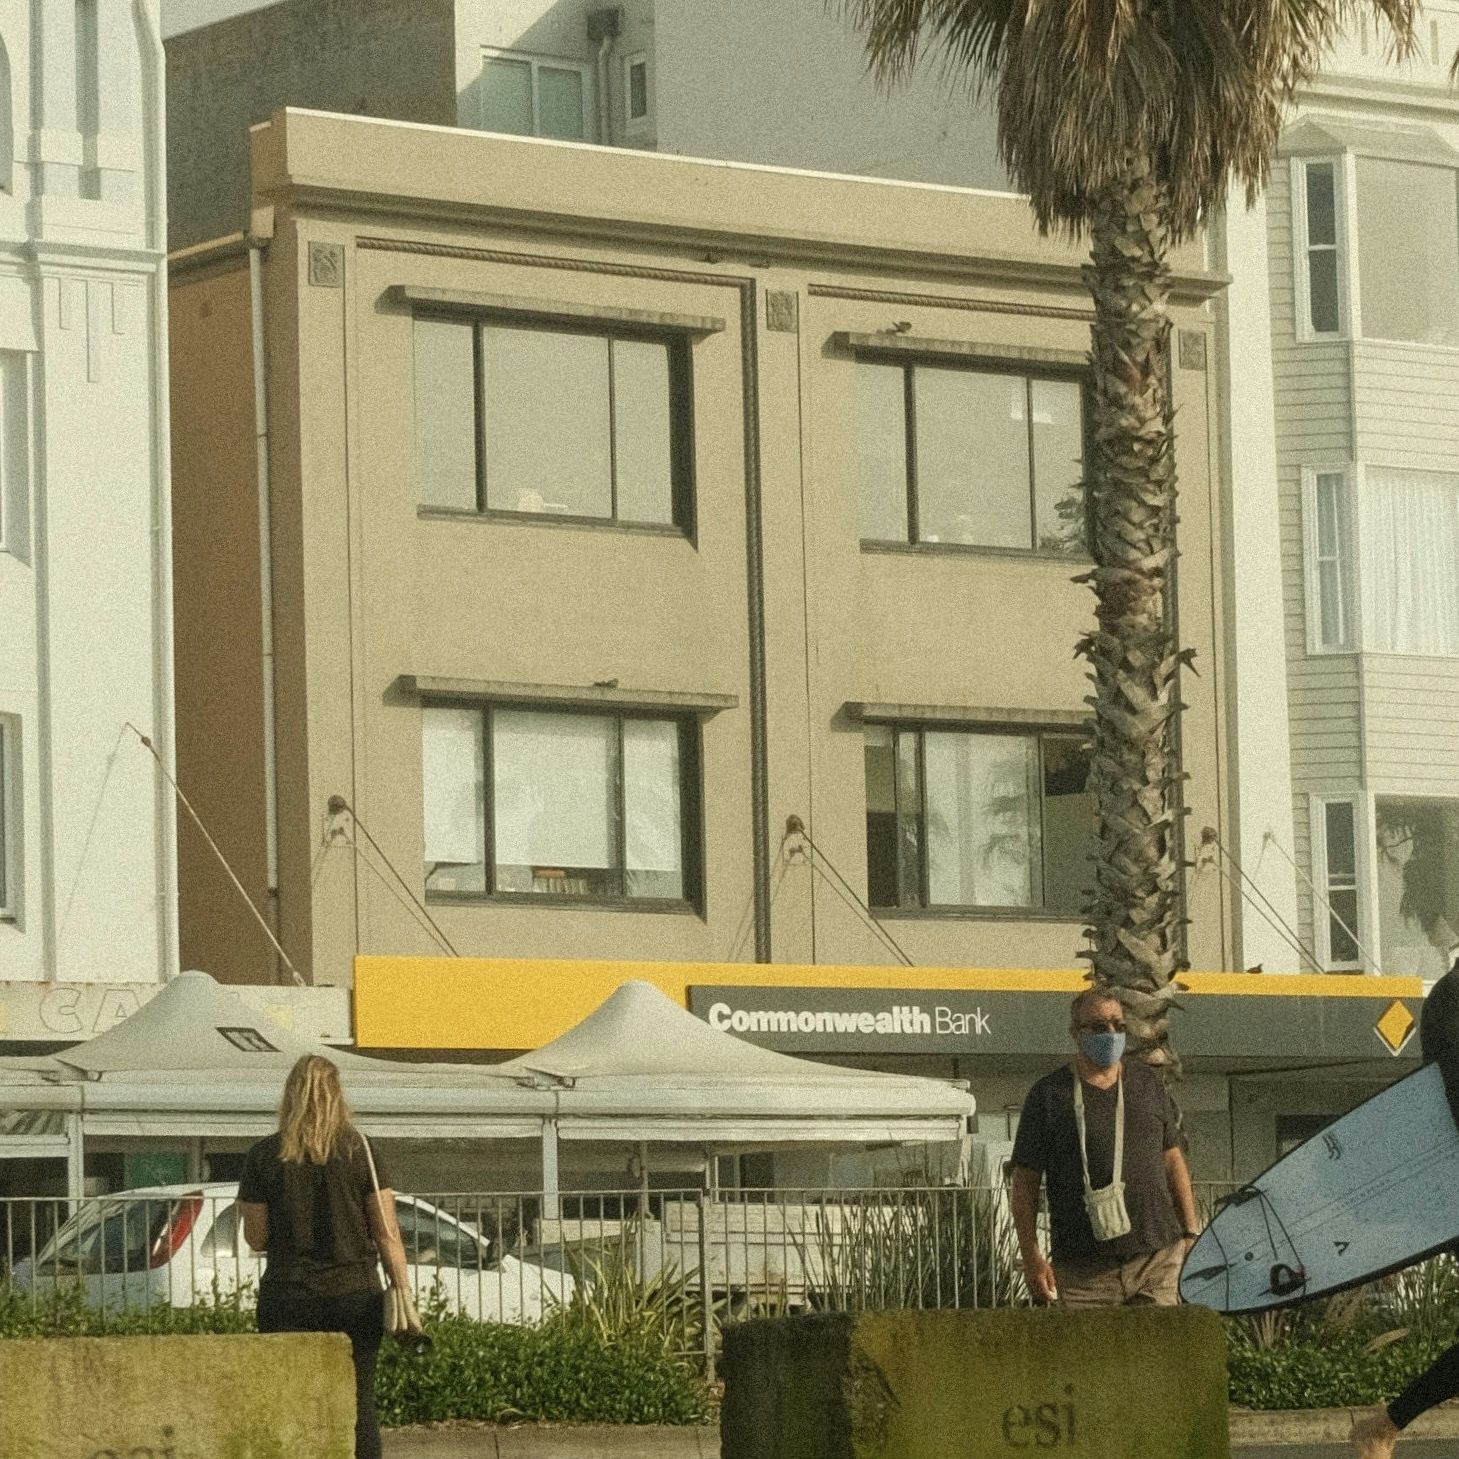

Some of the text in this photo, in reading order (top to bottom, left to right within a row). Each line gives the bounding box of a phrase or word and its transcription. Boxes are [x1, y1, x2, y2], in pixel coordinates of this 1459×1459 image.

[708, 1002, 992, 1036] Commonwealth Bank
[1001, 1383, 1076, 1449] esi
